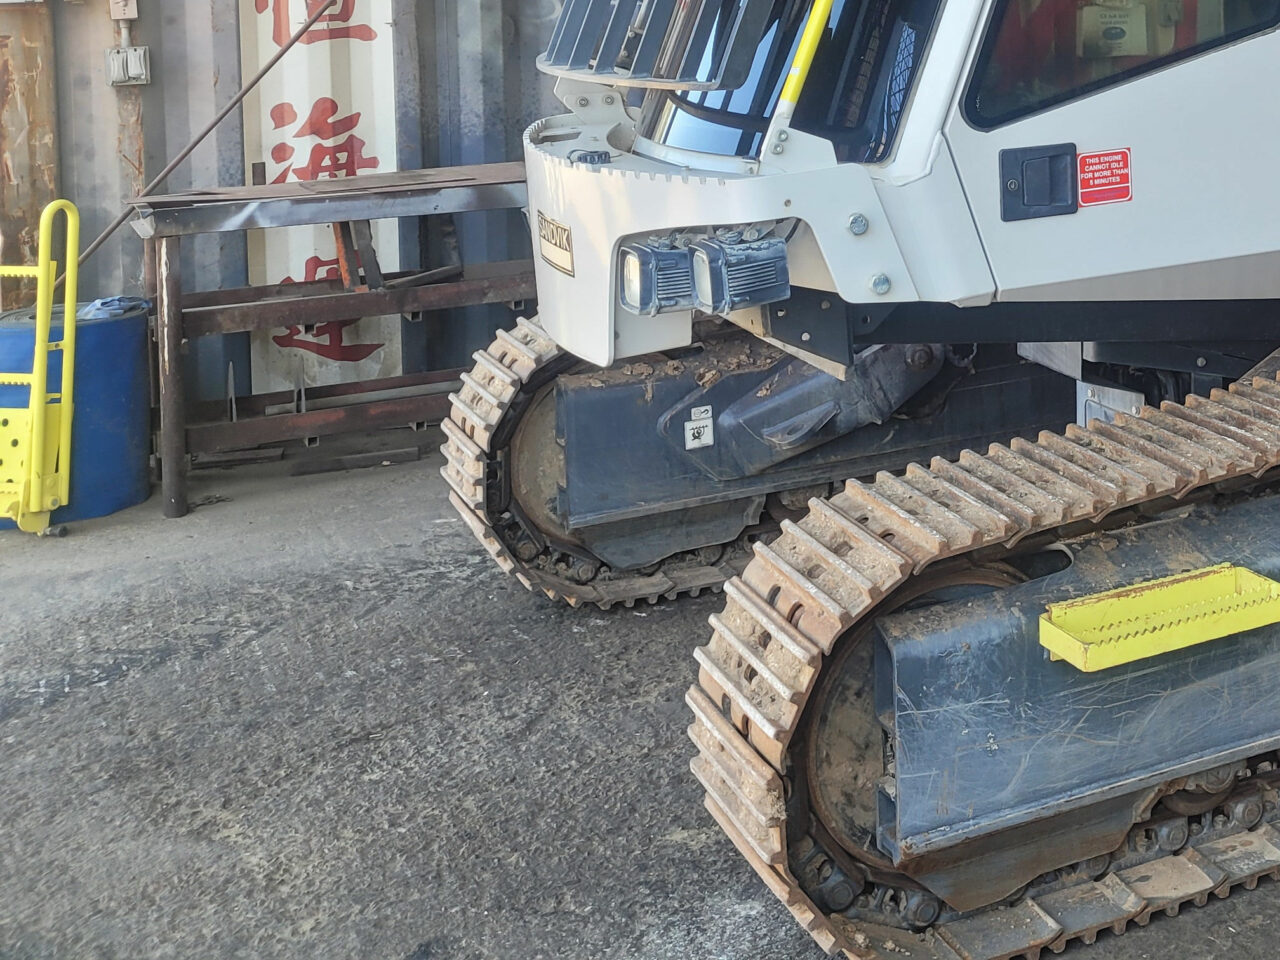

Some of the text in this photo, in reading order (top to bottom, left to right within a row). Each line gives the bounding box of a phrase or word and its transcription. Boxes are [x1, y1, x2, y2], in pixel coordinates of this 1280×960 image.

[1085, 163, 1109, 171] CANNOT
[1095, 176, 1120, 184] MINUTES
[539, 217, 570, 252] SANDVIK
